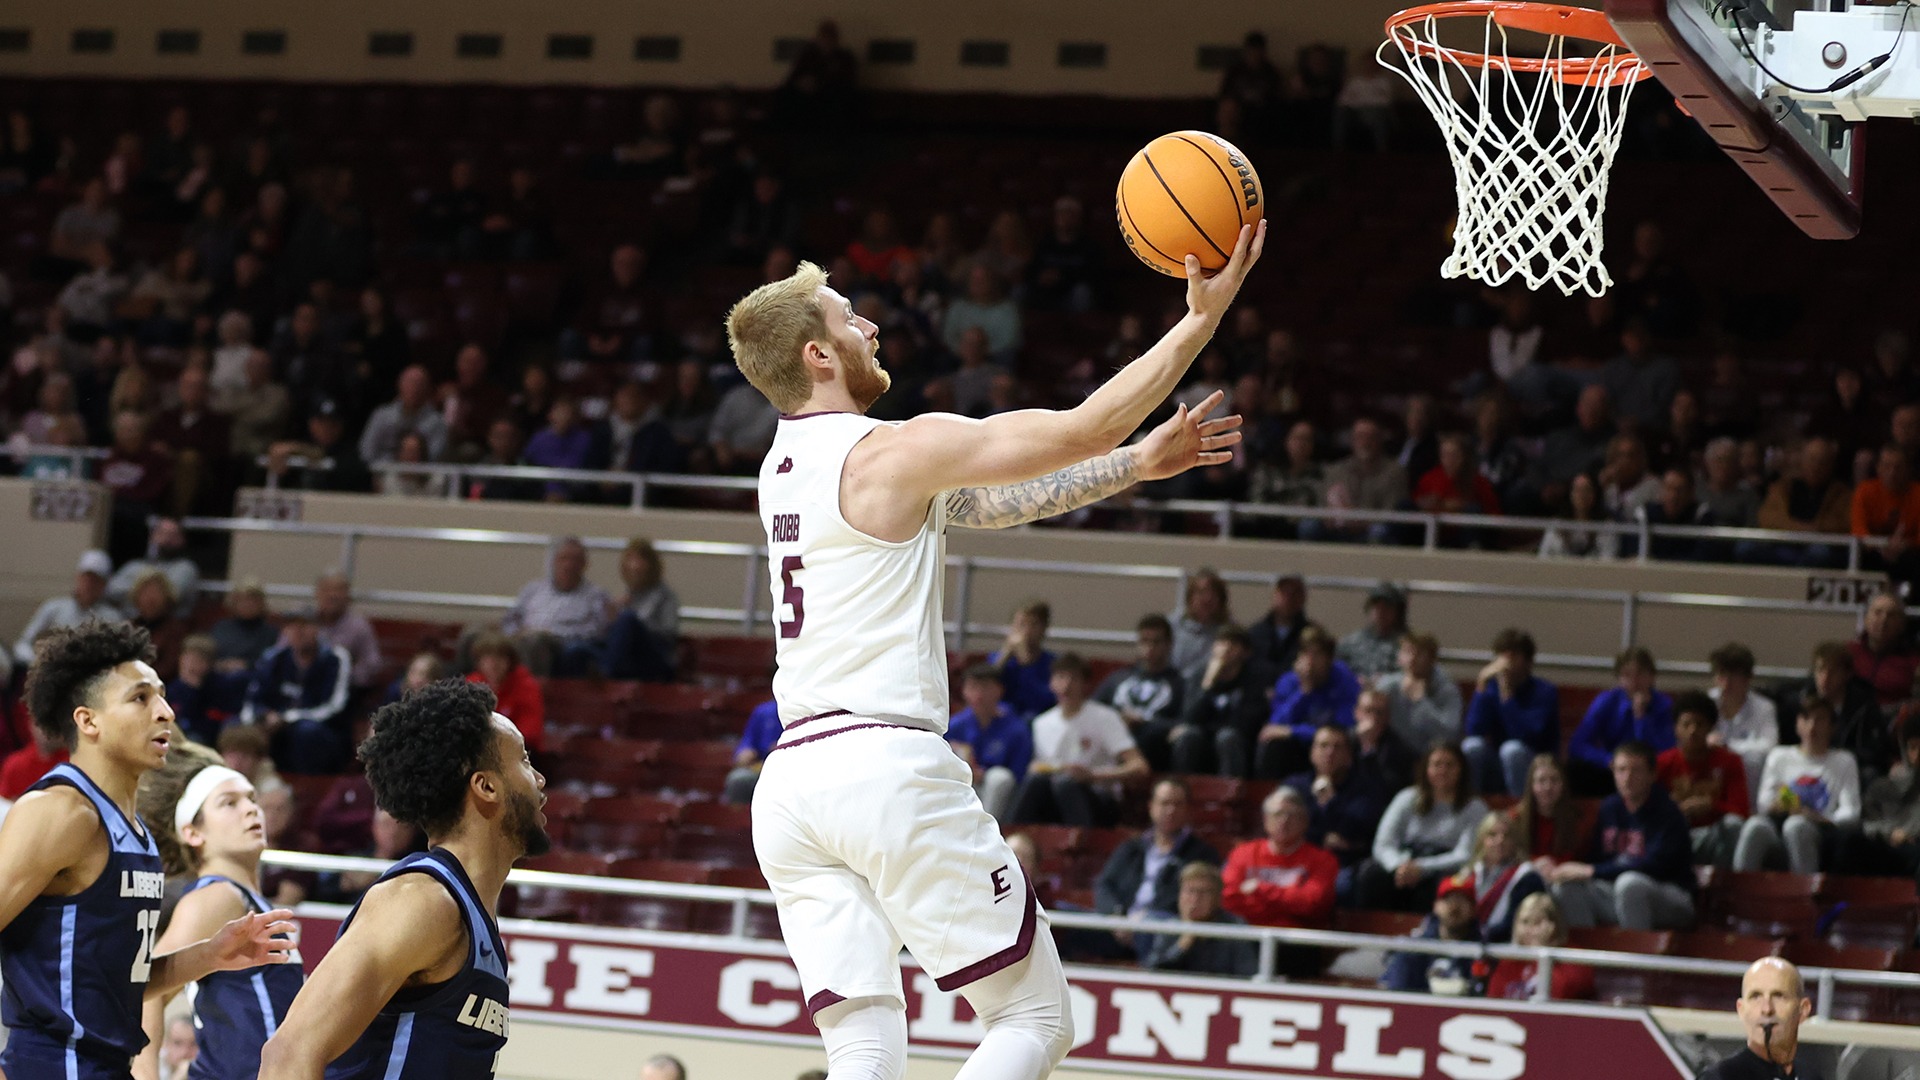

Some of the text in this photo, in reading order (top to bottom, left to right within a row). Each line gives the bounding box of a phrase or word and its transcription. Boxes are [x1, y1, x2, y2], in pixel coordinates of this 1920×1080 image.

[1209, 137, 1259, 211] Wils
[772, 513, 800, 543] ROBB
[780, 555, 805, 639] 5
[990, 864, 1012, 898] E
[717, 958, 1527, 1080] CLNELS
